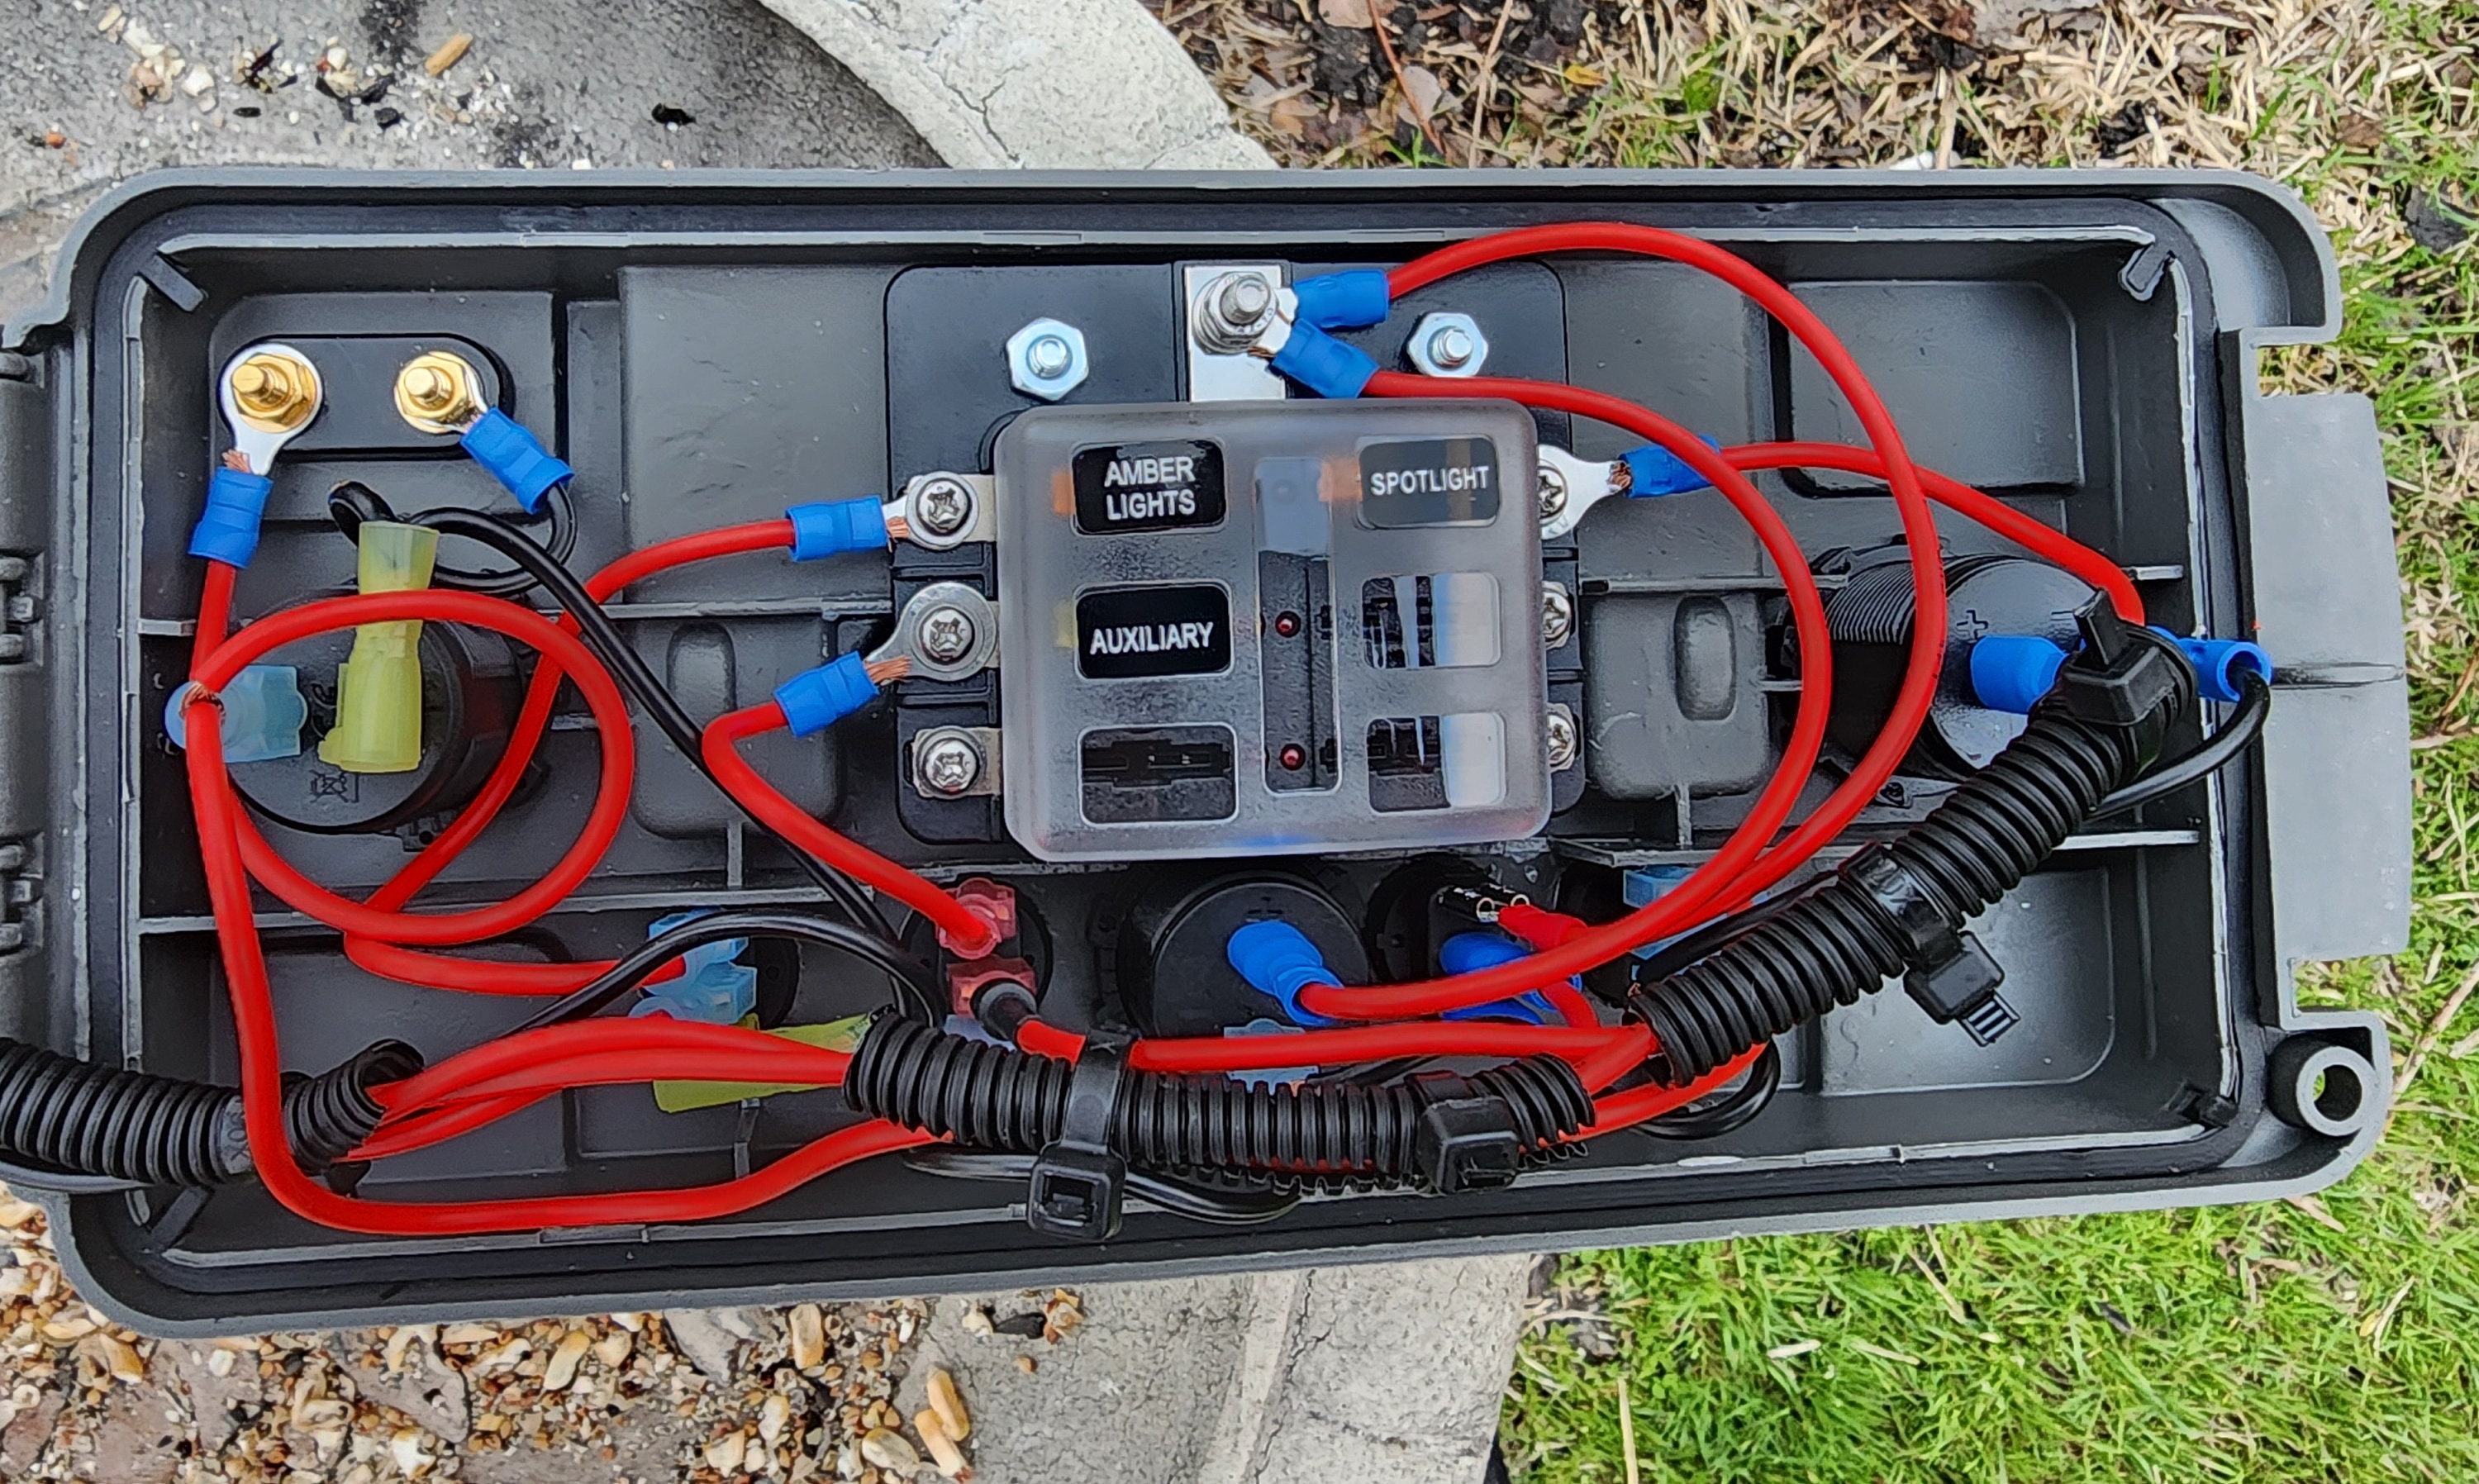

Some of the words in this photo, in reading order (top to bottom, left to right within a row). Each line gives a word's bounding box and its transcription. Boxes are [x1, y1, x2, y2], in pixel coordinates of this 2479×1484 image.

[1104, 456, 1197, 488] AMBER
[1370, 465, 1489, 496] SPOTLIGHT
[1106, 489, 1197, 521] LIGHTS
[1089, 621, 1215, 655] AUXILIARY
